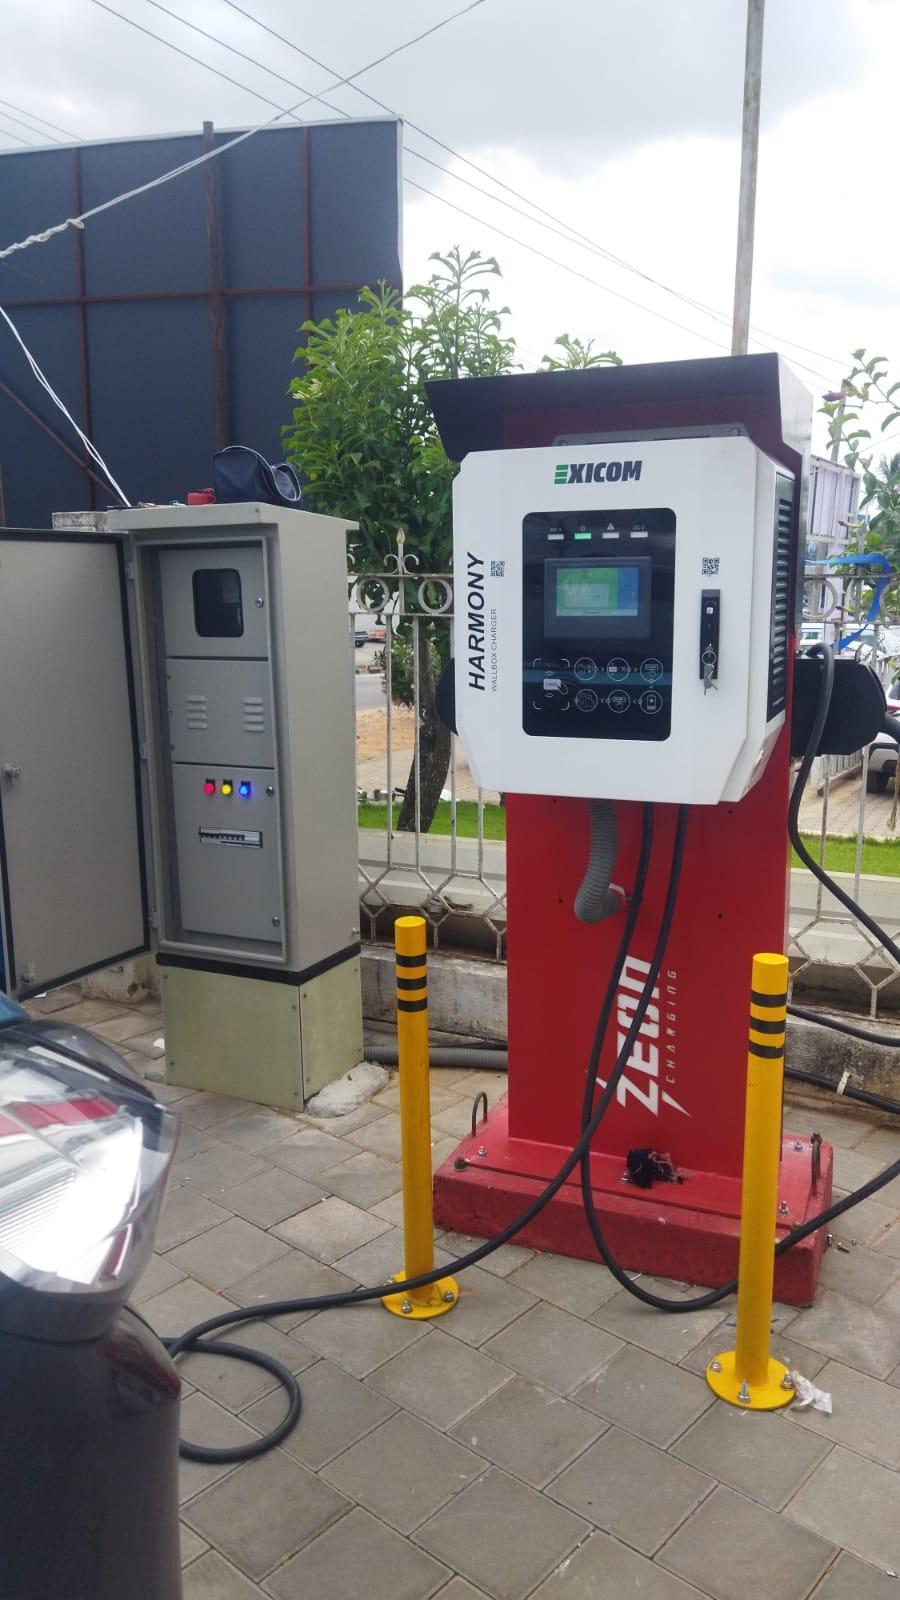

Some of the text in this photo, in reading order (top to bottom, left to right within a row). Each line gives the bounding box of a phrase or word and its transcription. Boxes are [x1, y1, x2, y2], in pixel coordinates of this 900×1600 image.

[554, 460, 643, 484] EXICOM
[467, 551, 486, 691] HARMONY
[490, 652, 498, 692] WALLBOX
[665, 970, 677, 1084] CHARGING
